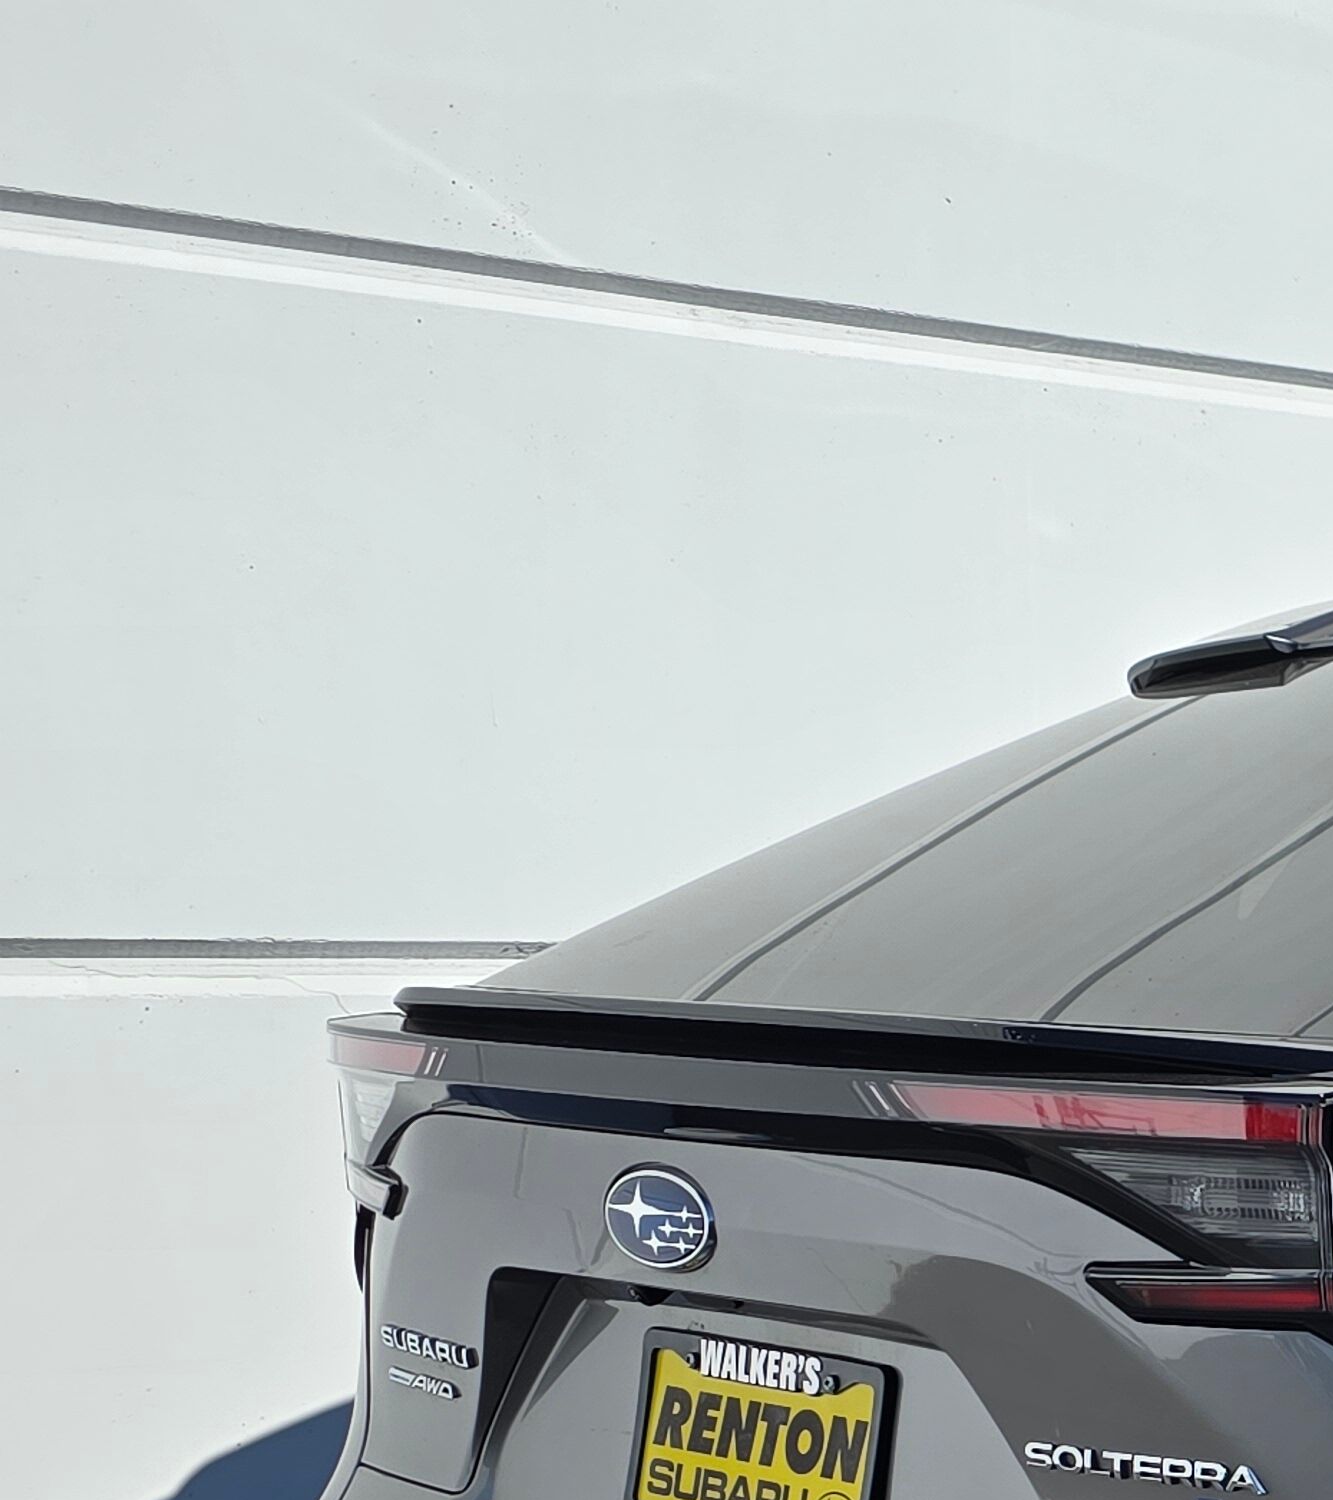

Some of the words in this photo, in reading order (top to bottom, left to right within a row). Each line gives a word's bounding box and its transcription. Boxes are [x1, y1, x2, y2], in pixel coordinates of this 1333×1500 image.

[380, 1325, 470, 1369] SUBARU
[700, 1338, 822, 1395] WALKER'S
[411, 1374, 454, 1400] AWD
[653, 1385, 869, 1484] RENTON
[1024, 1441, 1269, 1496] SOLTERRA
